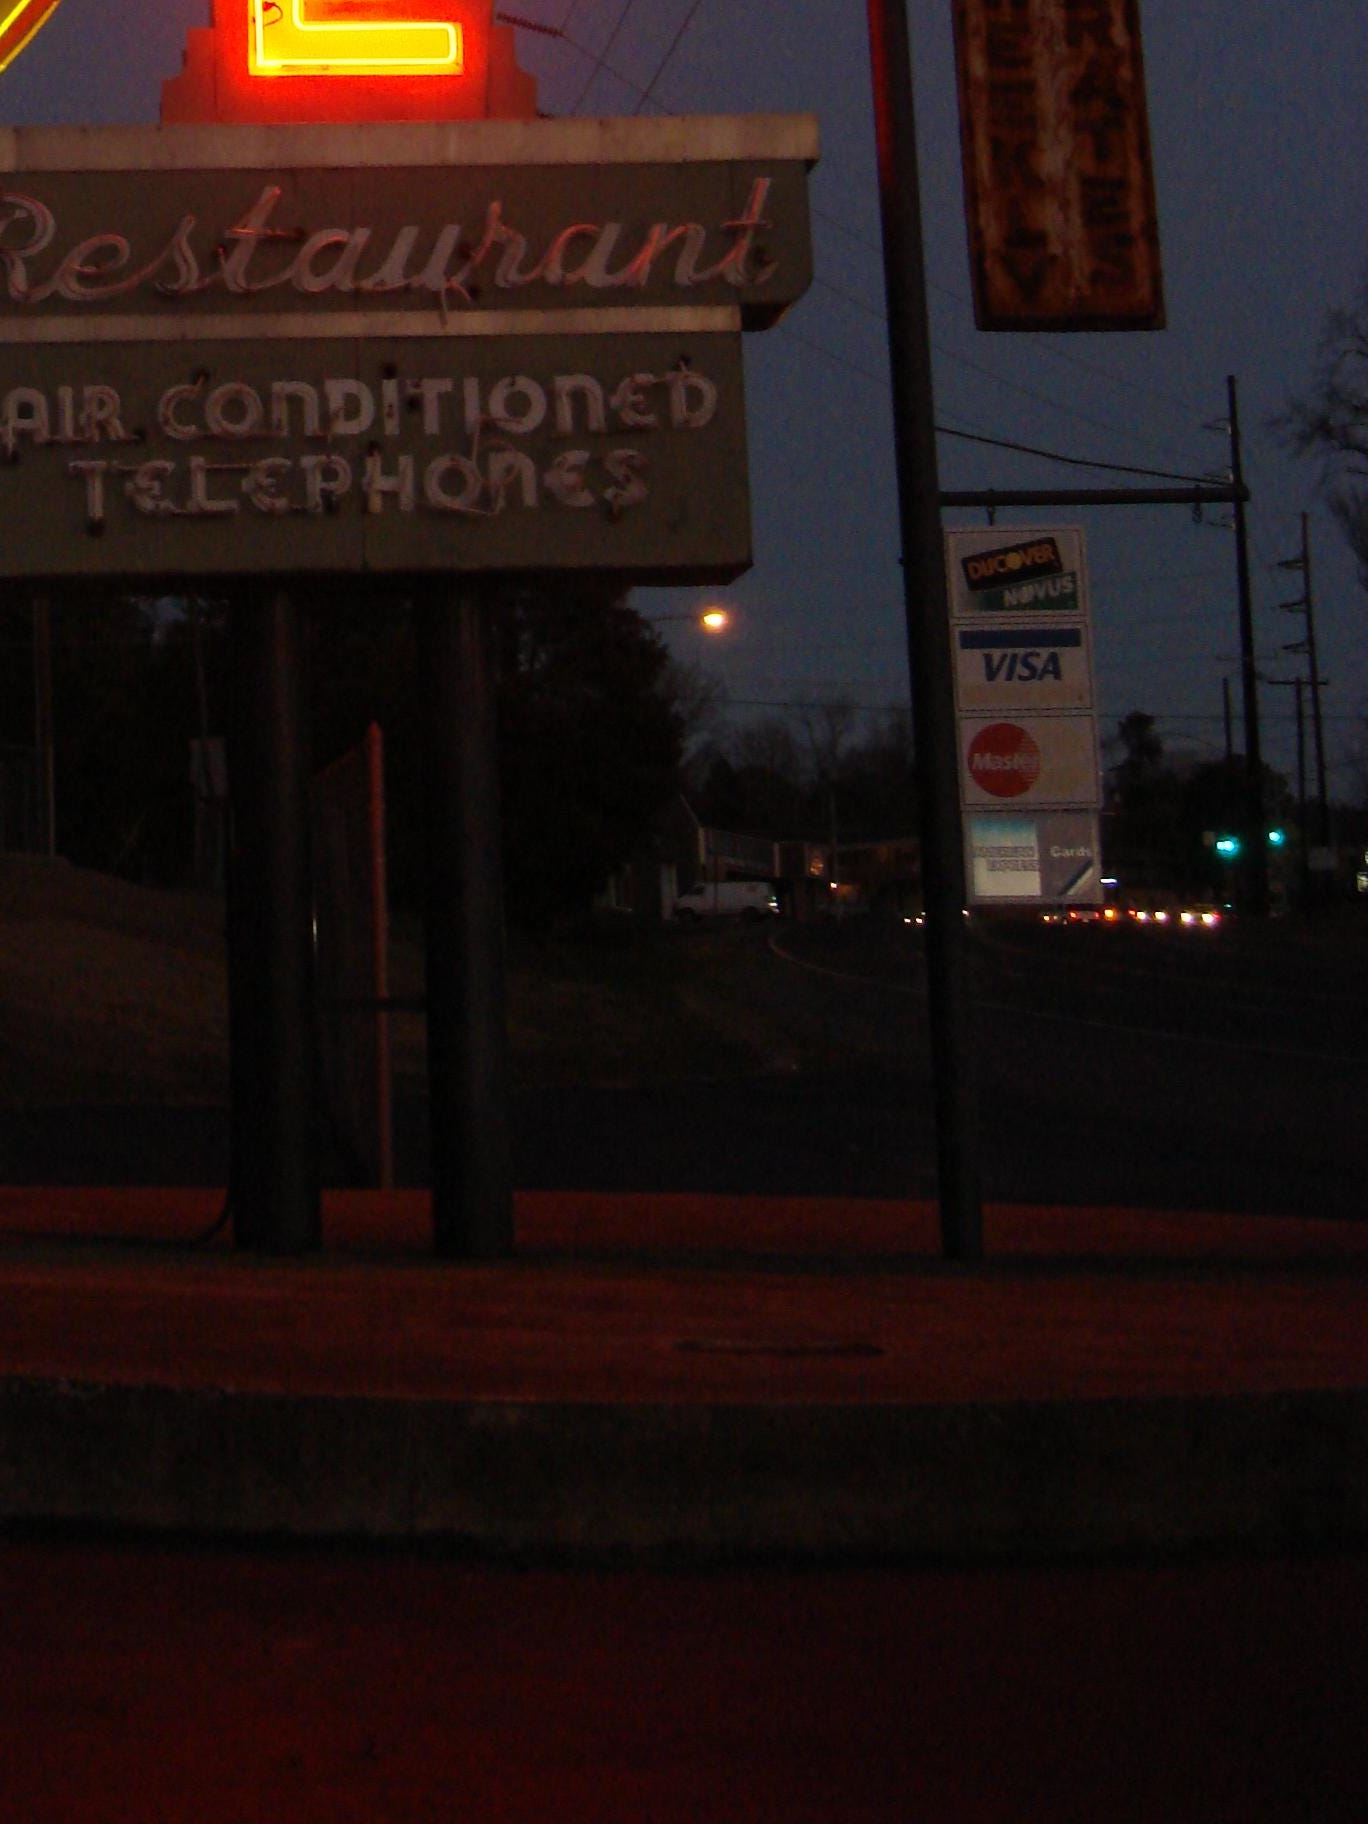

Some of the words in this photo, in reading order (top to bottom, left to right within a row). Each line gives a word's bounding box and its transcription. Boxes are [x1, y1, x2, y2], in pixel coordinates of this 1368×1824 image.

[0, 384, 131, 448] AIR
[1003, 576, 1074, 608] NOVUS
[982, 651, 1063, 682] VISA
[1050, 845, 1092, 858] Cards
